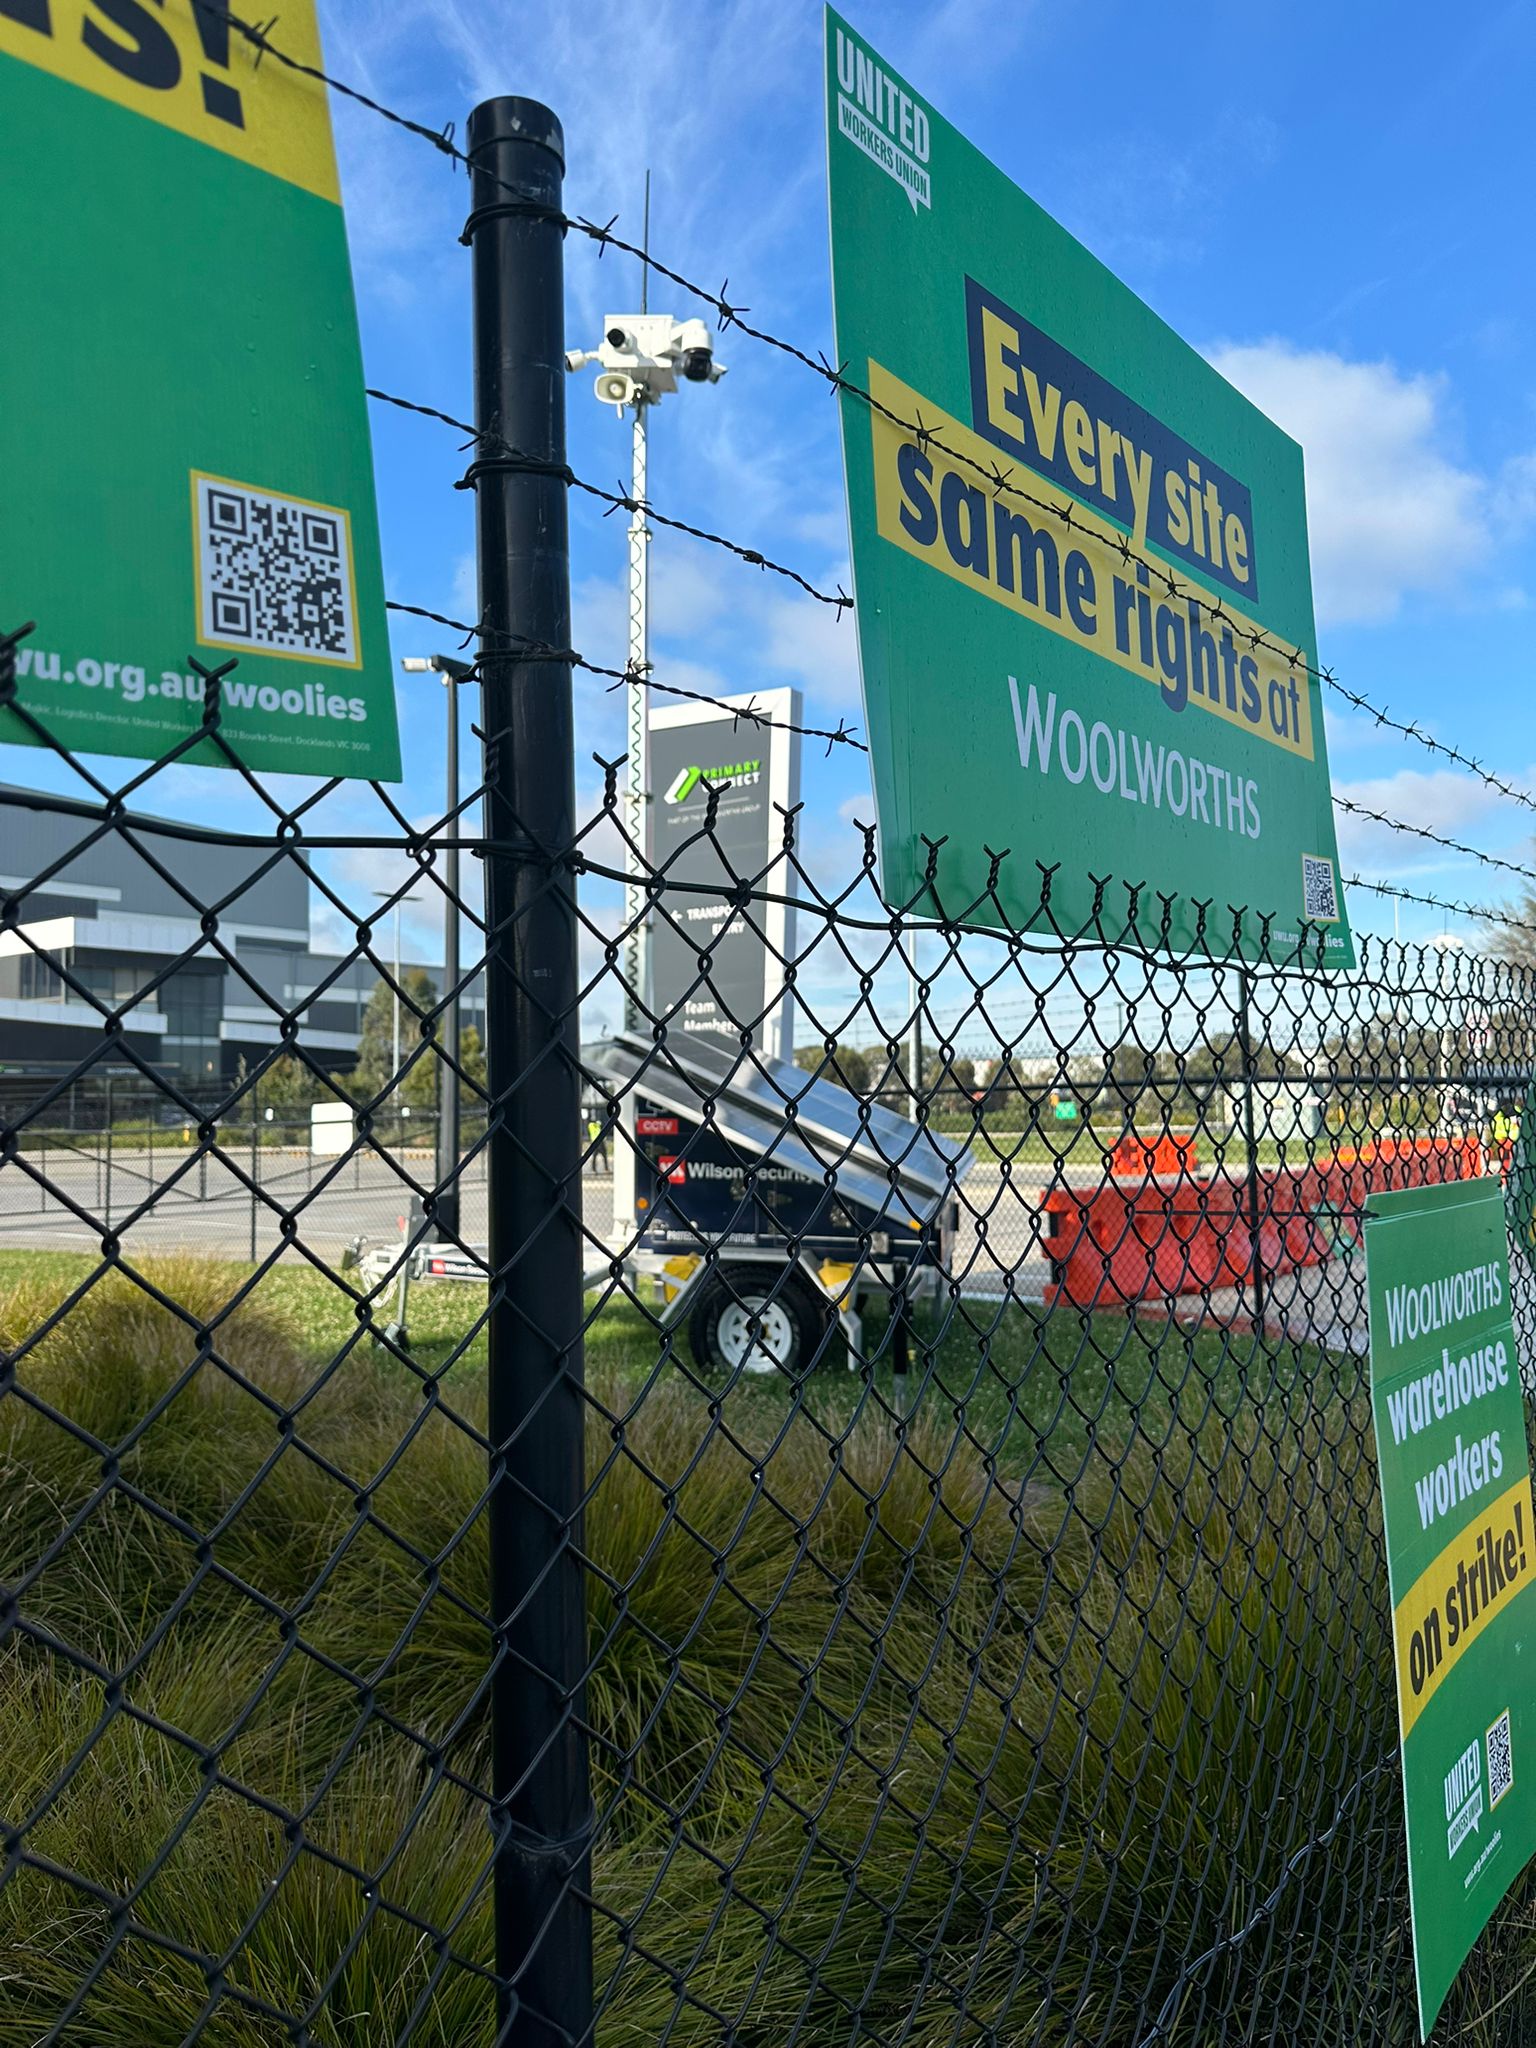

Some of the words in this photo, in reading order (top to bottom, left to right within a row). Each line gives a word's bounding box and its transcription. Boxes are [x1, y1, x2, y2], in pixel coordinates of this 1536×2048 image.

[836, 28, 930, 164] UNITED
[841, 103, 893, 170] WORKERS
[895, 152, 928, 200] UNION
[981, 305, 1153, 549] Every
[1164, 458, 1250, 584] site
[897, 442, 1098, 637] same
[1112, 562, 1263, 723] rights
[1268, 676, 1301, 744] at
[702, 760, 760, 779] PRIMARY
[1007, 674, 1262, 840] WOOLWORTHS
[685, 1000, 716, 1015] Team
[642, 1120, 673, 1132] CCTV
[687, 1162, 744, 1179] Wilson
[1384, 1260, 1502, 1348] WOOLWORTHS
[1386, 1340, 1509, 1446] warehouse
[1414, 1430, 1503, 1531] workers
[1409, 1607, 1443, 1696] on
[1445, 1501, 1527, 1647] strike!
[1443, 1738, 1481, 1822] UNITED
